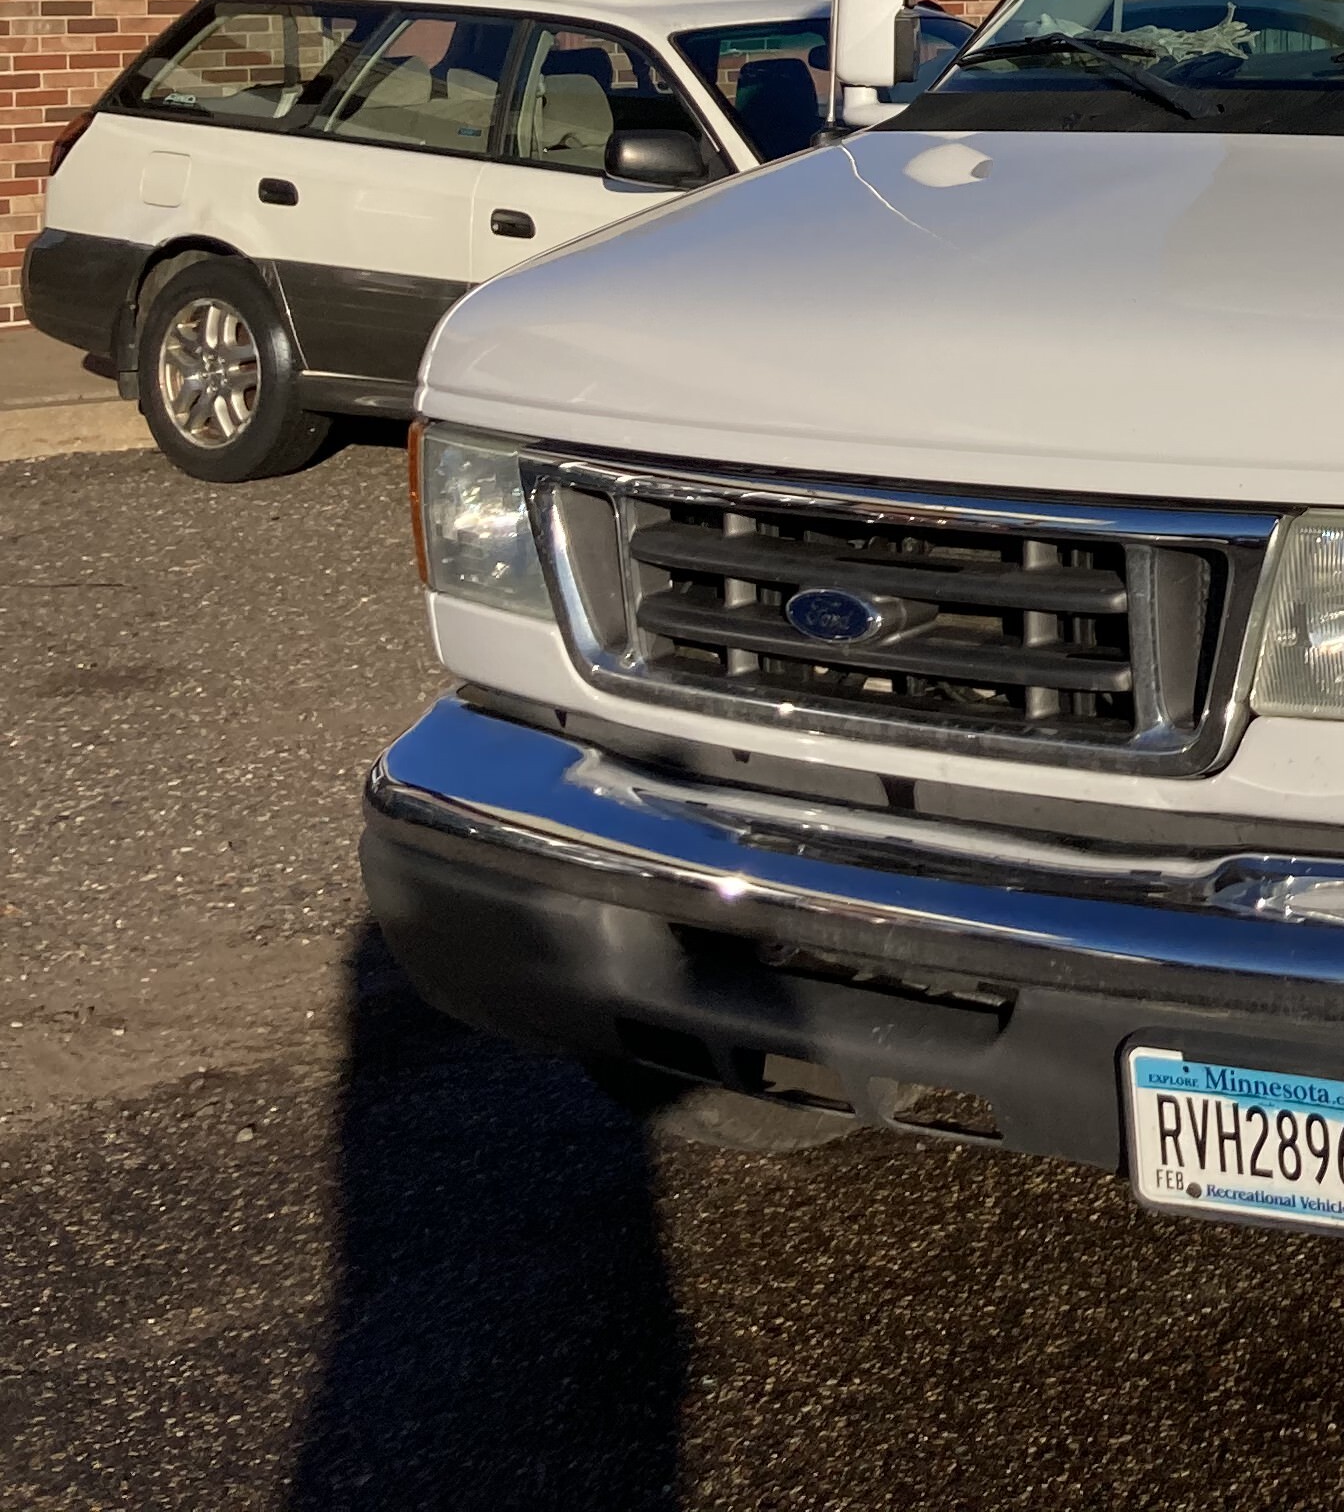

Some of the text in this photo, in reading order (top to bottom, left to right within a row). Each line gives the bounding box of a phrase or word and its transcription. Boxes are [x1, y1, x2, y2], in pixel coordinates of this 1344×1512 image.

[1148, 1073, 1200, 1088] EXPLORE
[1156, 1168, 1184, 1191] FEB
[1205, 1183, 1296, 1208] Recreational
